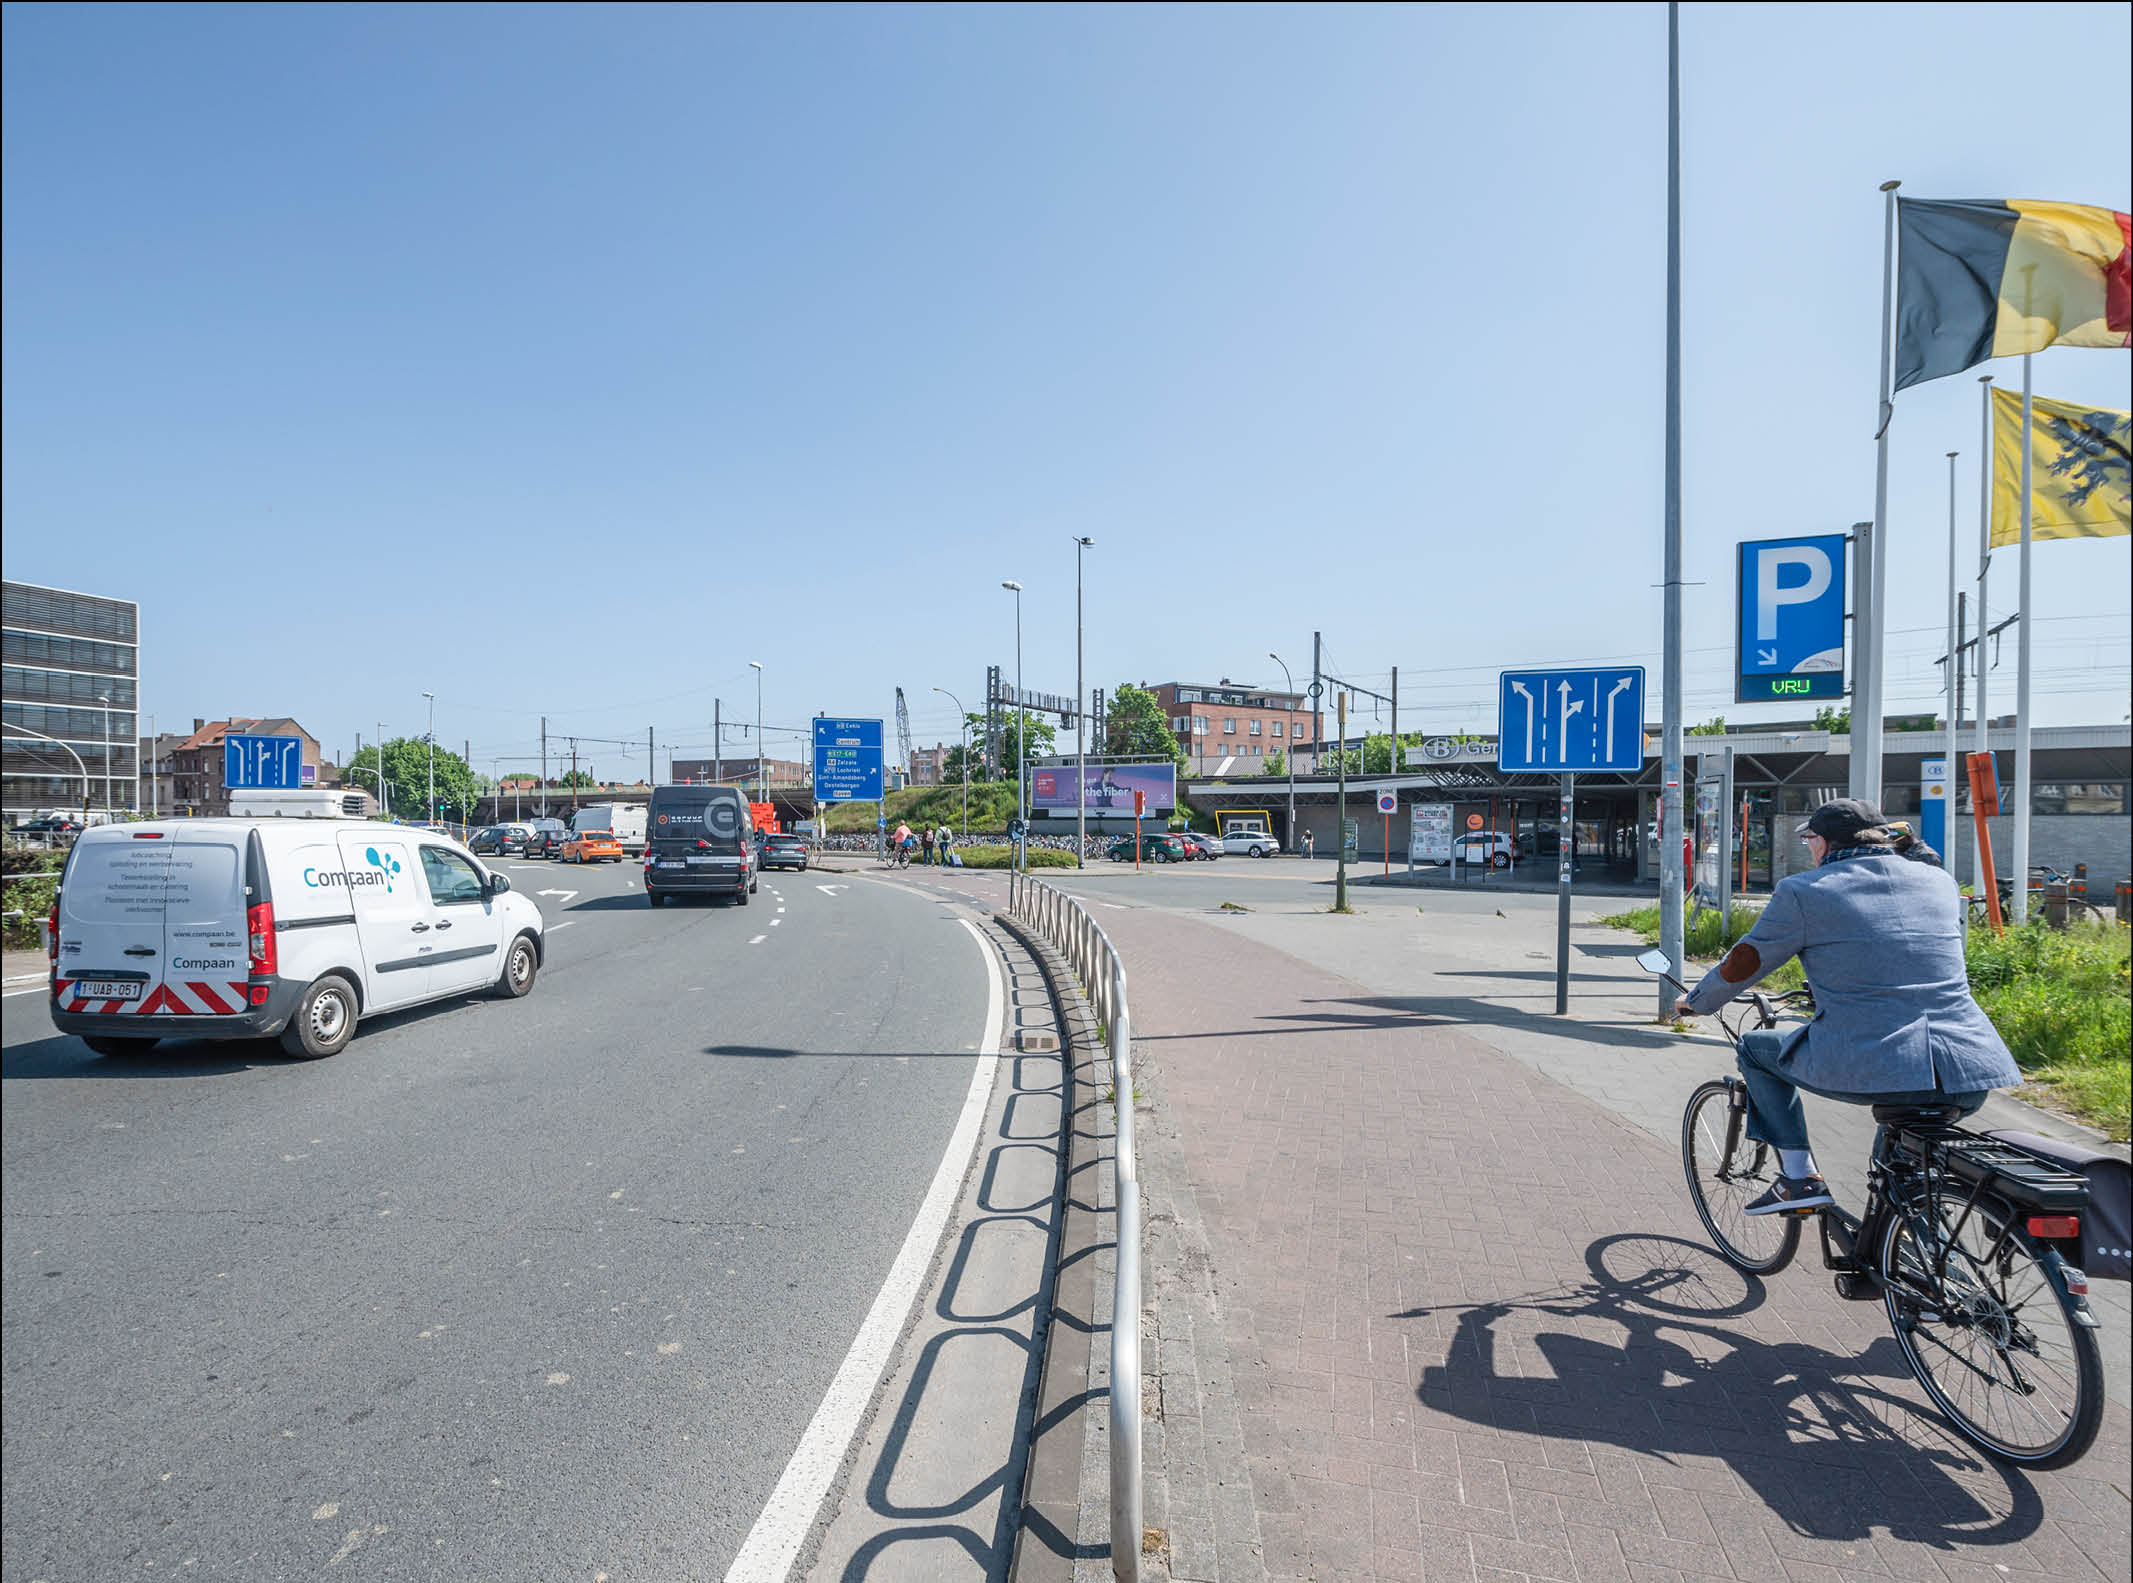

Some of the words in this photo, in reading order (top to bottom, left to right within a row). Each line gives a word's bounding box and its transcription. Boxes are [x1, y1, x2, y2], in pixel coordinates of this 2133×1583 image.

[1757, 546, 1832, 640] P
[1085, 787, 1102, 796] the
[1103, 787, 1129, 797] fiber
[304, 868, 384, 890] Compaan
[173, 930, 236, 938] www.compaan.be
[173, 957, 235, 971] Compaan
